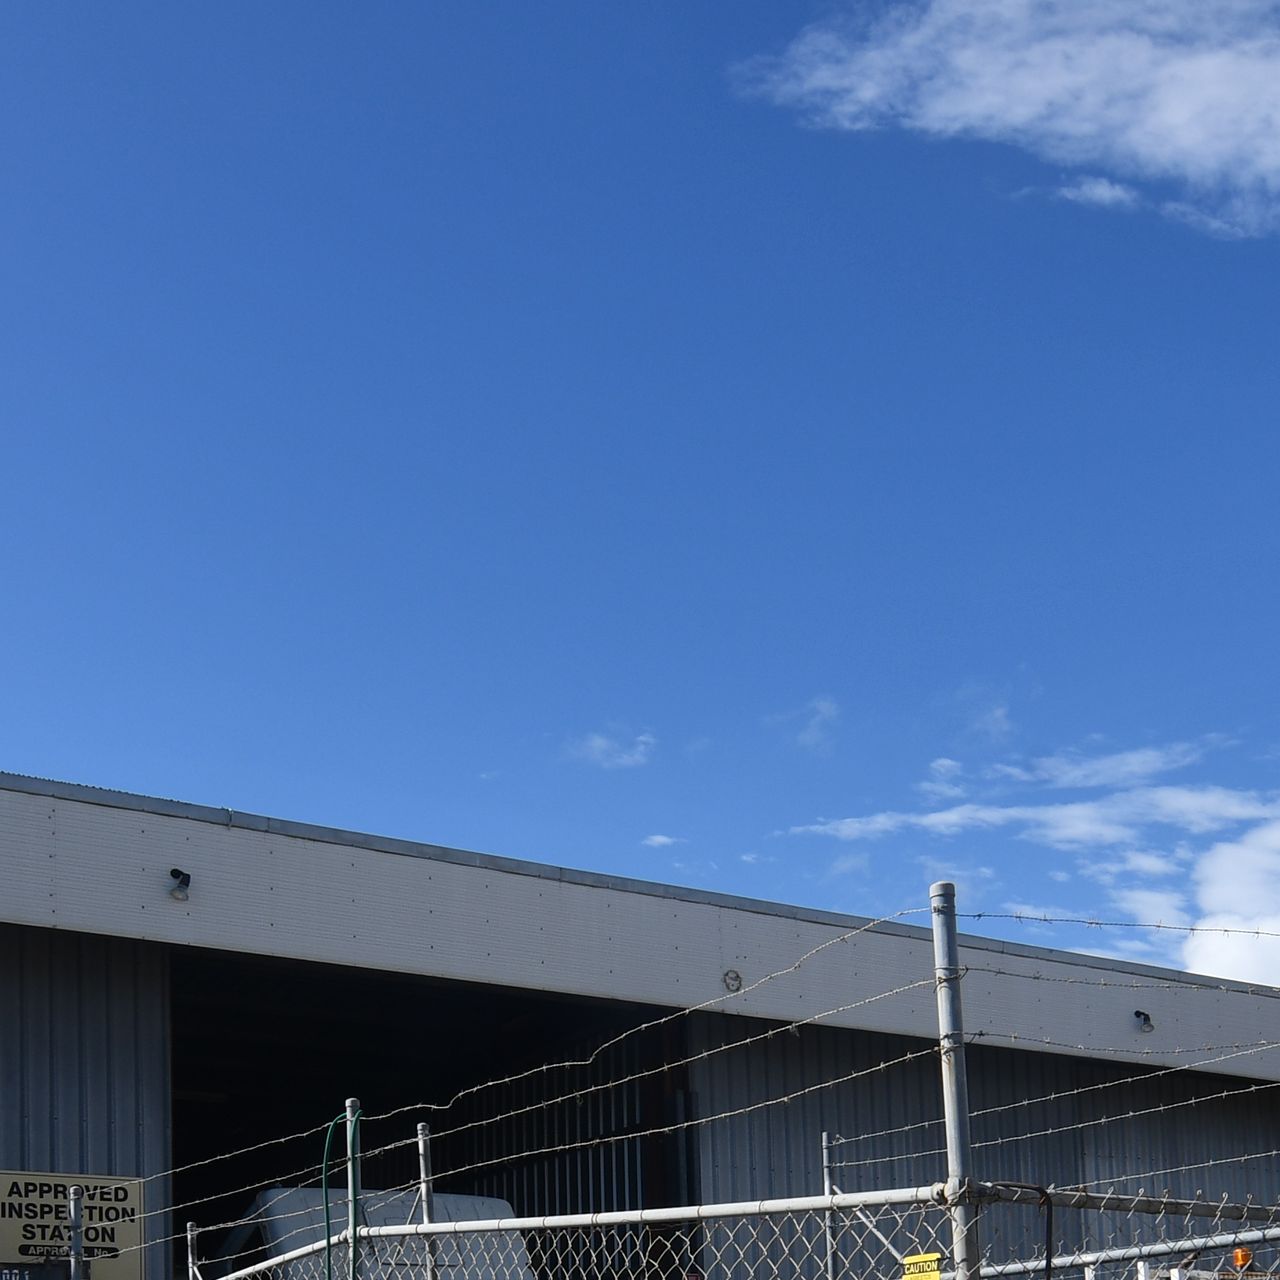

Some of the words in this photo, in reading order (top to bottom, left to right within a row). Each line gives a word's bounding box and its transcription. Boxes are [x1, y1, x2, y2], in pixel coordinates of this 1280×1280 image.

[7, 1182, 129, 1202] APPROVED
[0, 1202, 136, 1223] INSPETION
[22, 1224, 116, 1243] STAON
[28, 1246, 88, 1257] APPROL
[905, 1261, 938, 1274] CAUTION
